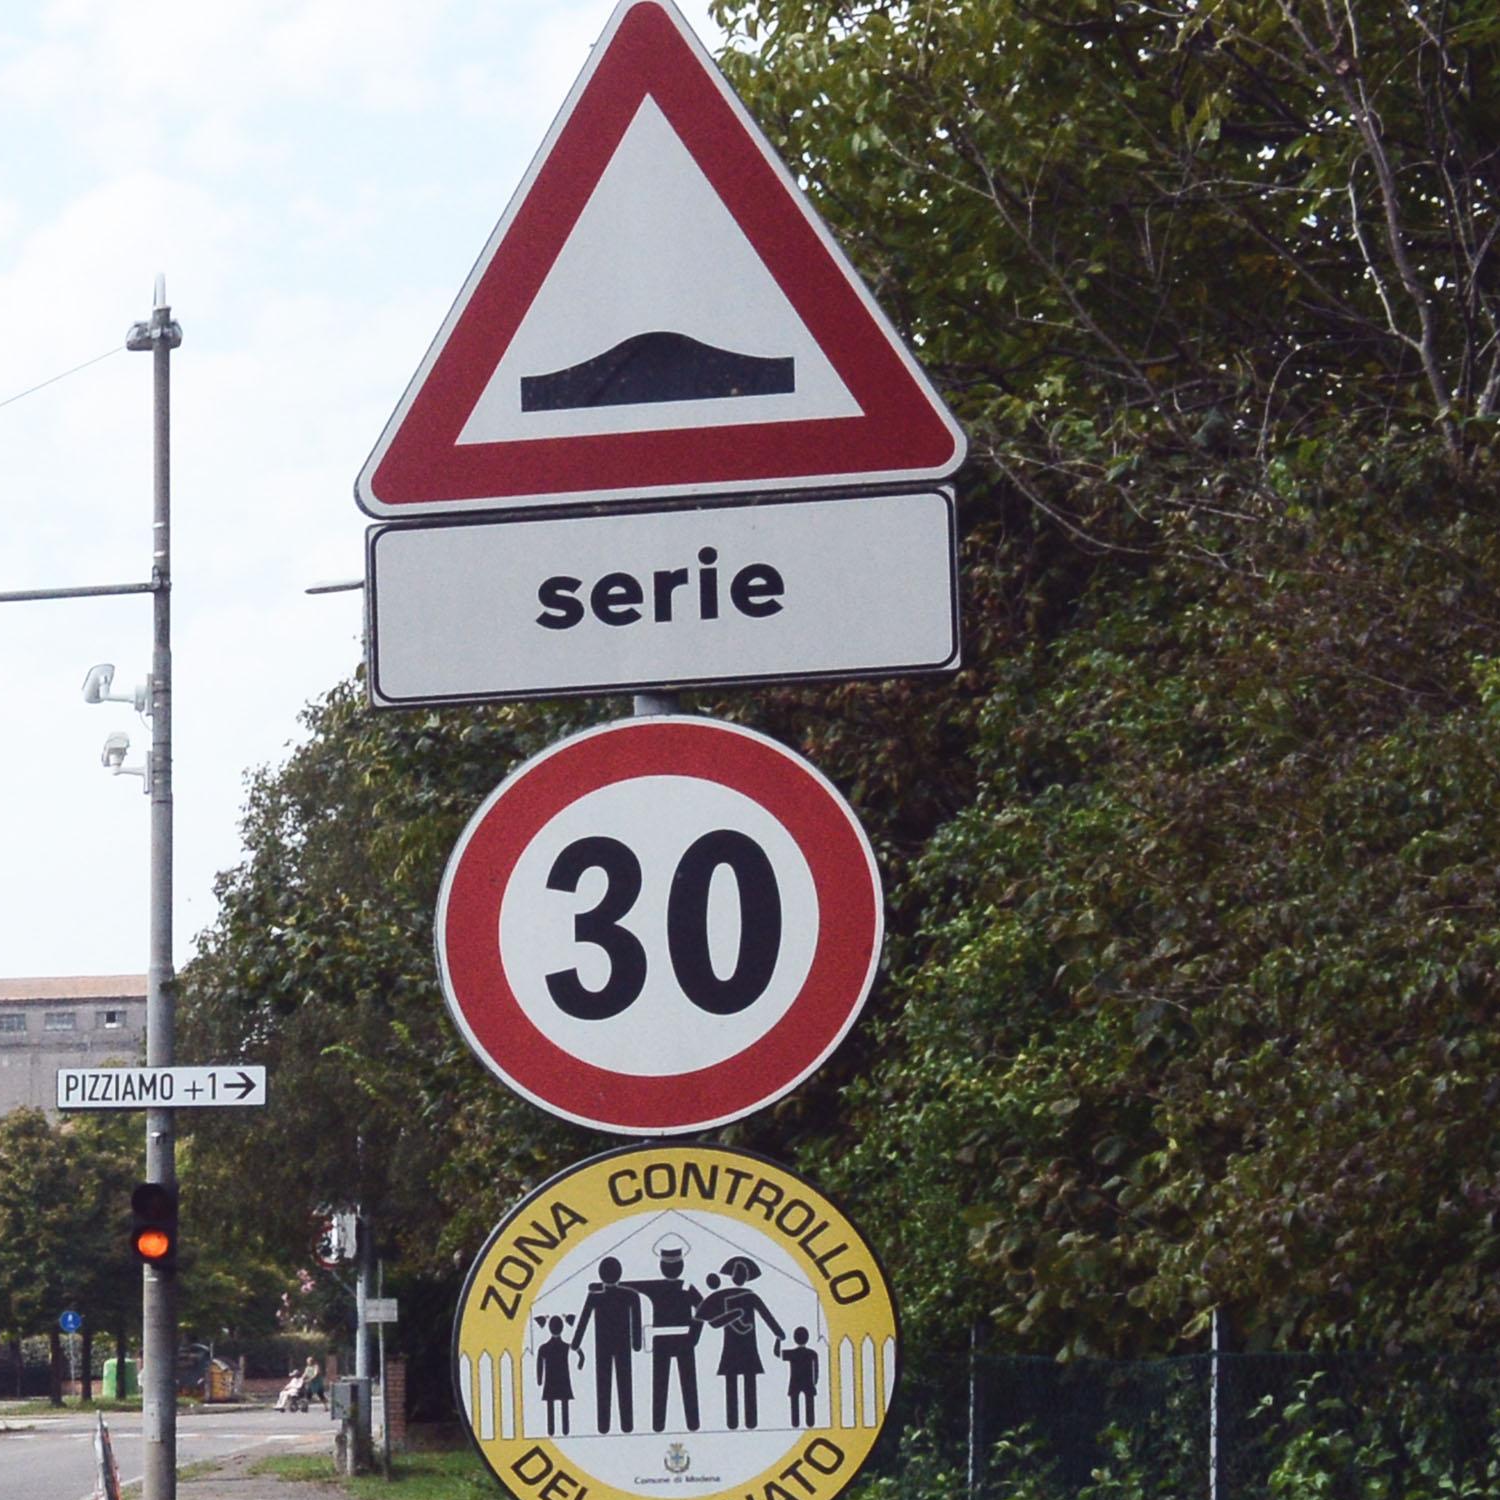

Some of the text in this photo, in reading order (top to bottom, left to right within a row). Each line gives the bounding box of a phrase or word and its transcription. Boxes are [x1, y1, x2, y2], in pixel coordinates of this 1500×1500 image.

[536, 546, 785, 630] serie
[545, 829, 782, 1021] 30
[65, 1073, 174, 1101] PIZZIAMO
[480, 1162, 871, 1320] ZONA CONTROLLO
[634, 1476, 670, 1485] Comune
